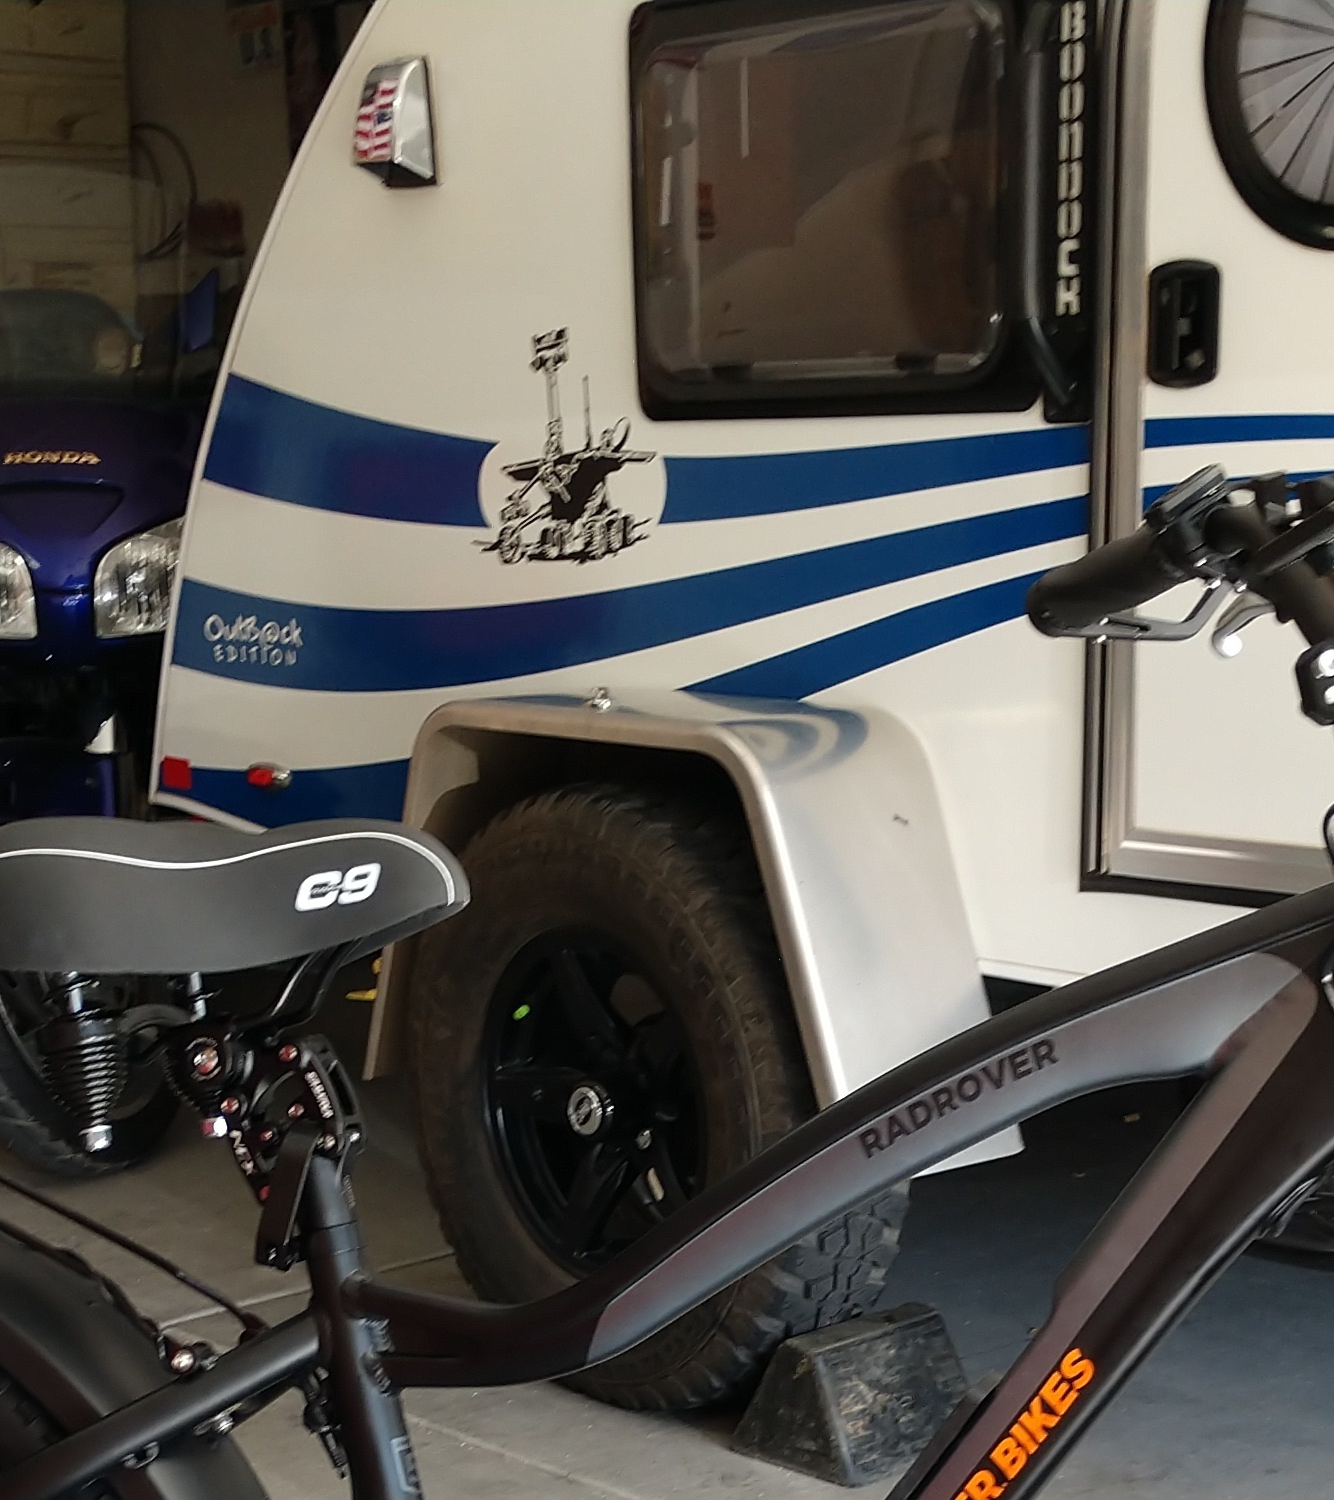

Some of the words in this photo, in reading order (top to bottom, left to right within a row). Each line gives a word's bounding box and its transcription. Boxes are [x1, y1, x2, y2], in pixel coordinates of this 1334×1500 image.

[1056, 0, 1087, 316] BOONDOCK
[3, 450, 101, 464] HONDA
[213, 645, 297, 666] EDITION
[294, 862, 381, 912] C9
[858, 1037, 1060, 1160] RADROVER
[989, 1347, 1097, 1480] BIKES
